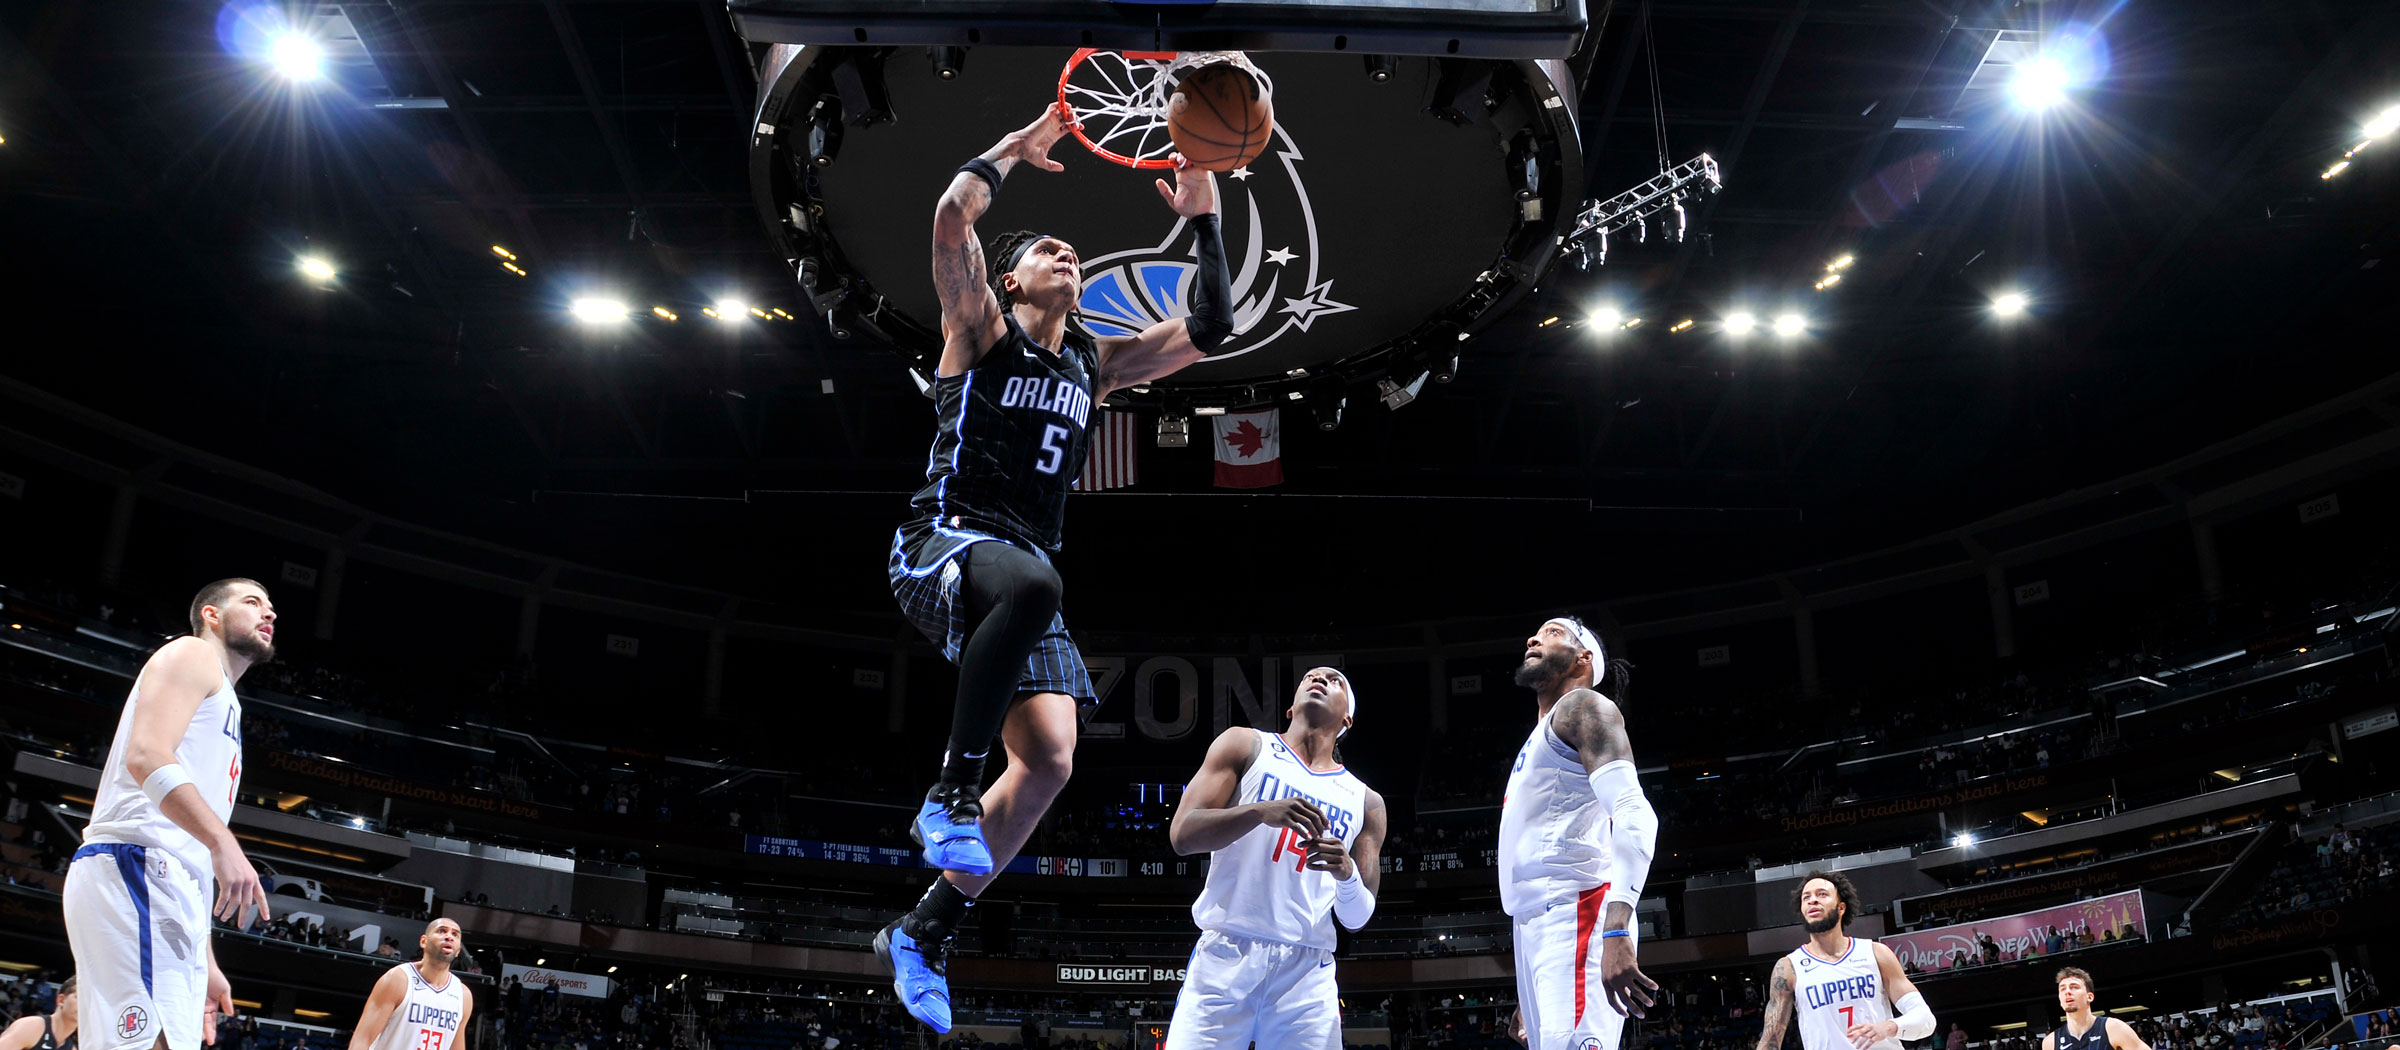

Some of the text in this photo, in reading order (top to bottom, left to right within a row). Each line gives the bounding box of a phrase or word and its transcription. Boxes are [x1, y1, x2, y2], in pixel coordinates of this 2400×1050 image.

[1035, 422, 1069, 475] 5
[2306, 500, 2330, 516] 205
[2022, 585, 2042, 599] 204
[268, 753, 541, 819] Holiday traditions start here
[1781, 774, 2048, 832] Holiday traditions start here
[759, 844, 805, 858] 17-23 74%
[824, 850, 870, 864] 14-39 36%
[1272, 826, 1309, 873] 14
[890, 856, 898, 865] 13
[1100, 861, 1116, 875] 101
[1395, 857, 1404, 871] 2
[1420, 859, 1464, 871] 21-24 88%
[1140, 862, 1163, 875] 4:10
[2028, 918, 2087, 946] Wrld
[1060, 968, 1096, 981] BUD
[1098, 968, 1147, 981] LIGHT
[561, 979, 588, 989] SPORTS
[1805, 974, 1875, 1010] CLIPPERS
[408, 1003, 458, 1031] CLIPPERS
[1838, 1006, 1853, 1029] 7
[417, 1028, 443, 1050] 33
